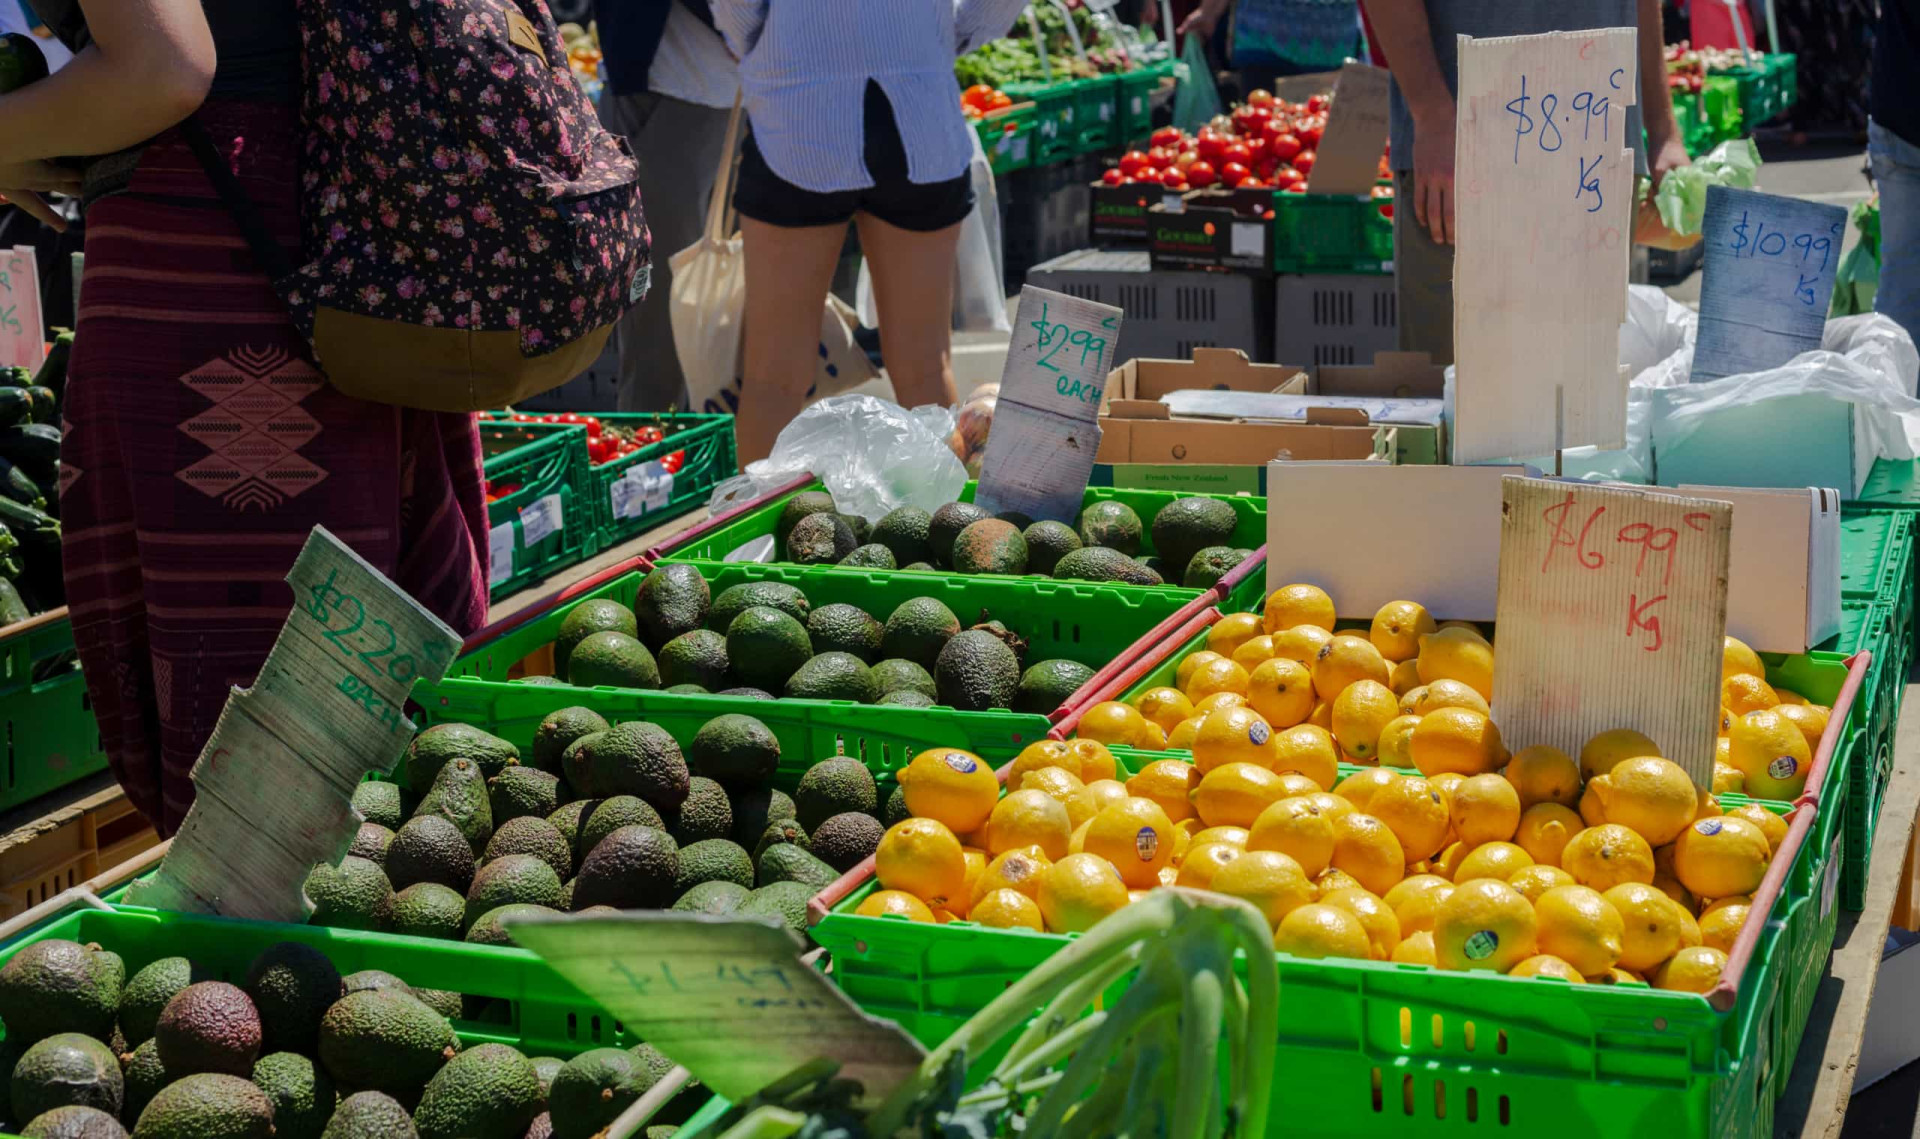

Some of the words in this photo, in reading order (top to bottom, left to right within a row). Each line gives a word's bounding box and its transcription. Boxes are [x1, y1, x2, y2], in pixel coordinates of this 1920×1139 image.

[1575, 155, 1603, 212] Kg
[1794, 274, 1819, 306] Kg
[1626, 594, 1668, 651] Kg
